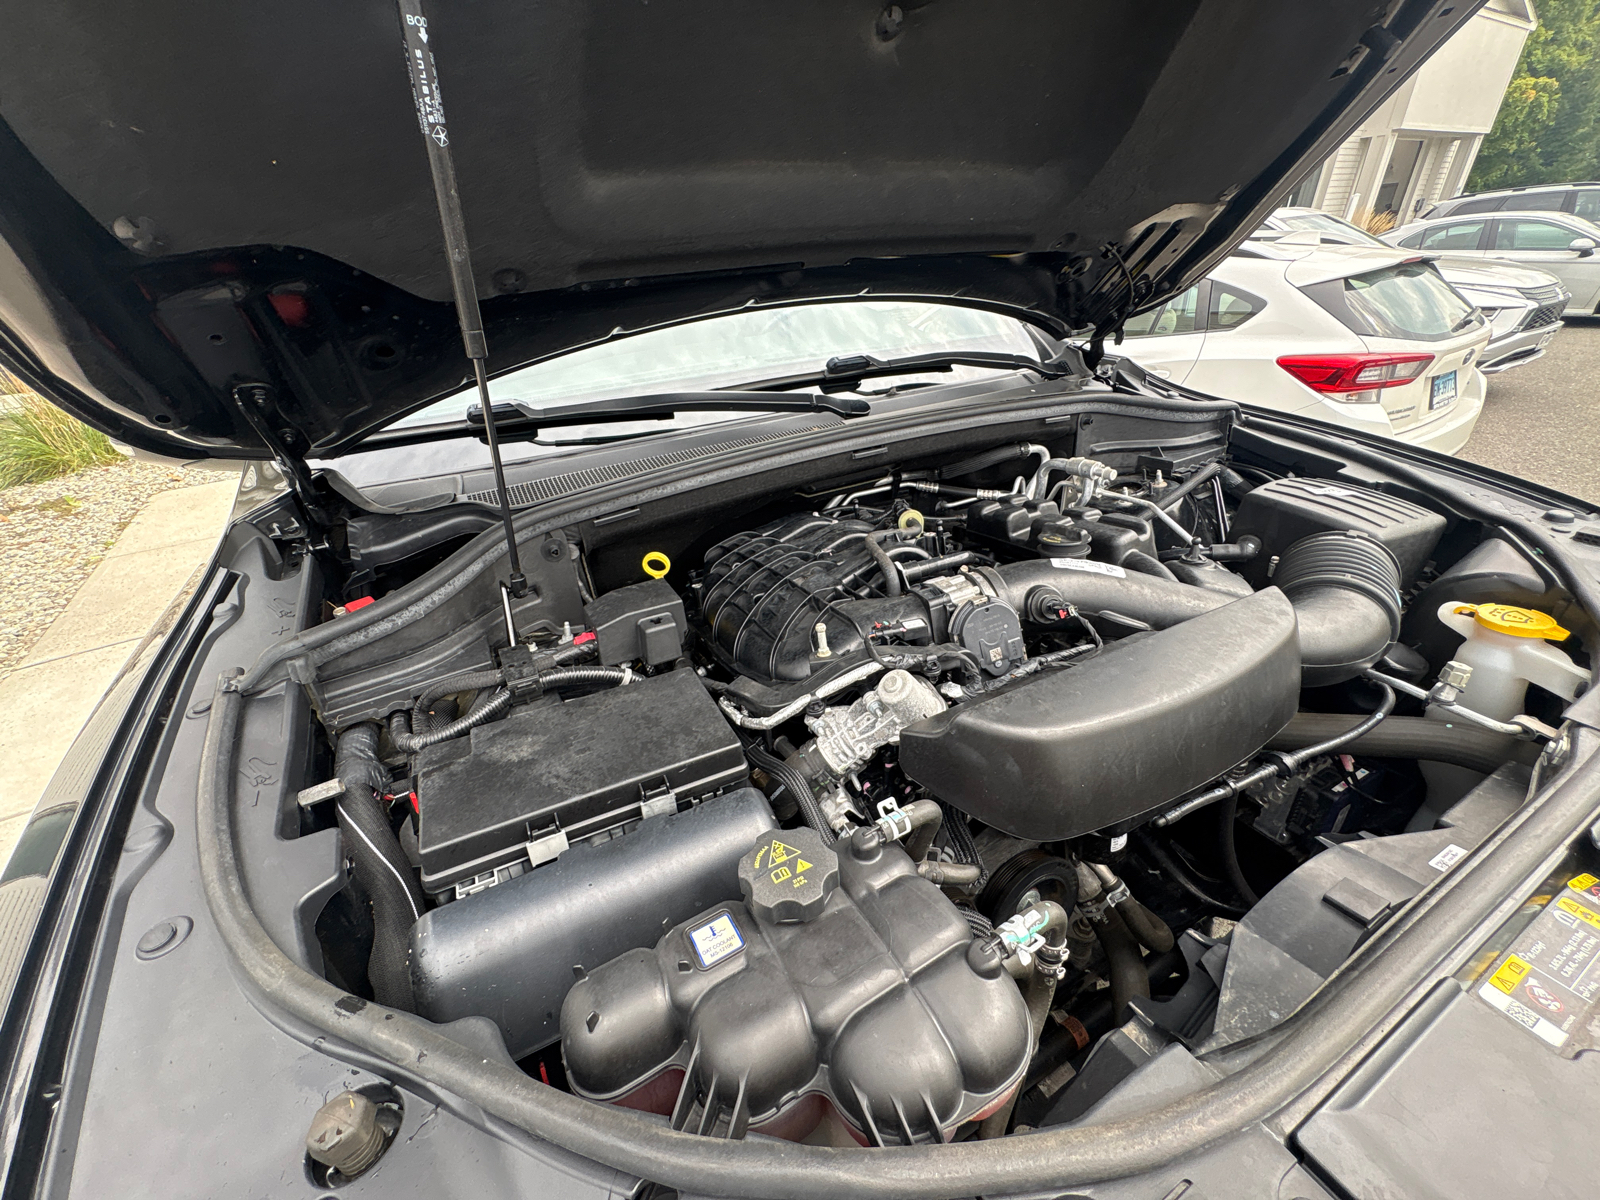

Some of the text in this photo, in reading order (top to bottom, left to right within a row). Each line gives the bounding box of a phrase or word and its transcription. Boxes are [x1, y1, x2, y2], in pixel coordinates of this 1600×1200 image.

[415, 48, 435, 124] STABILUS
[701, 934, 736, 956] OAT COOLANT
